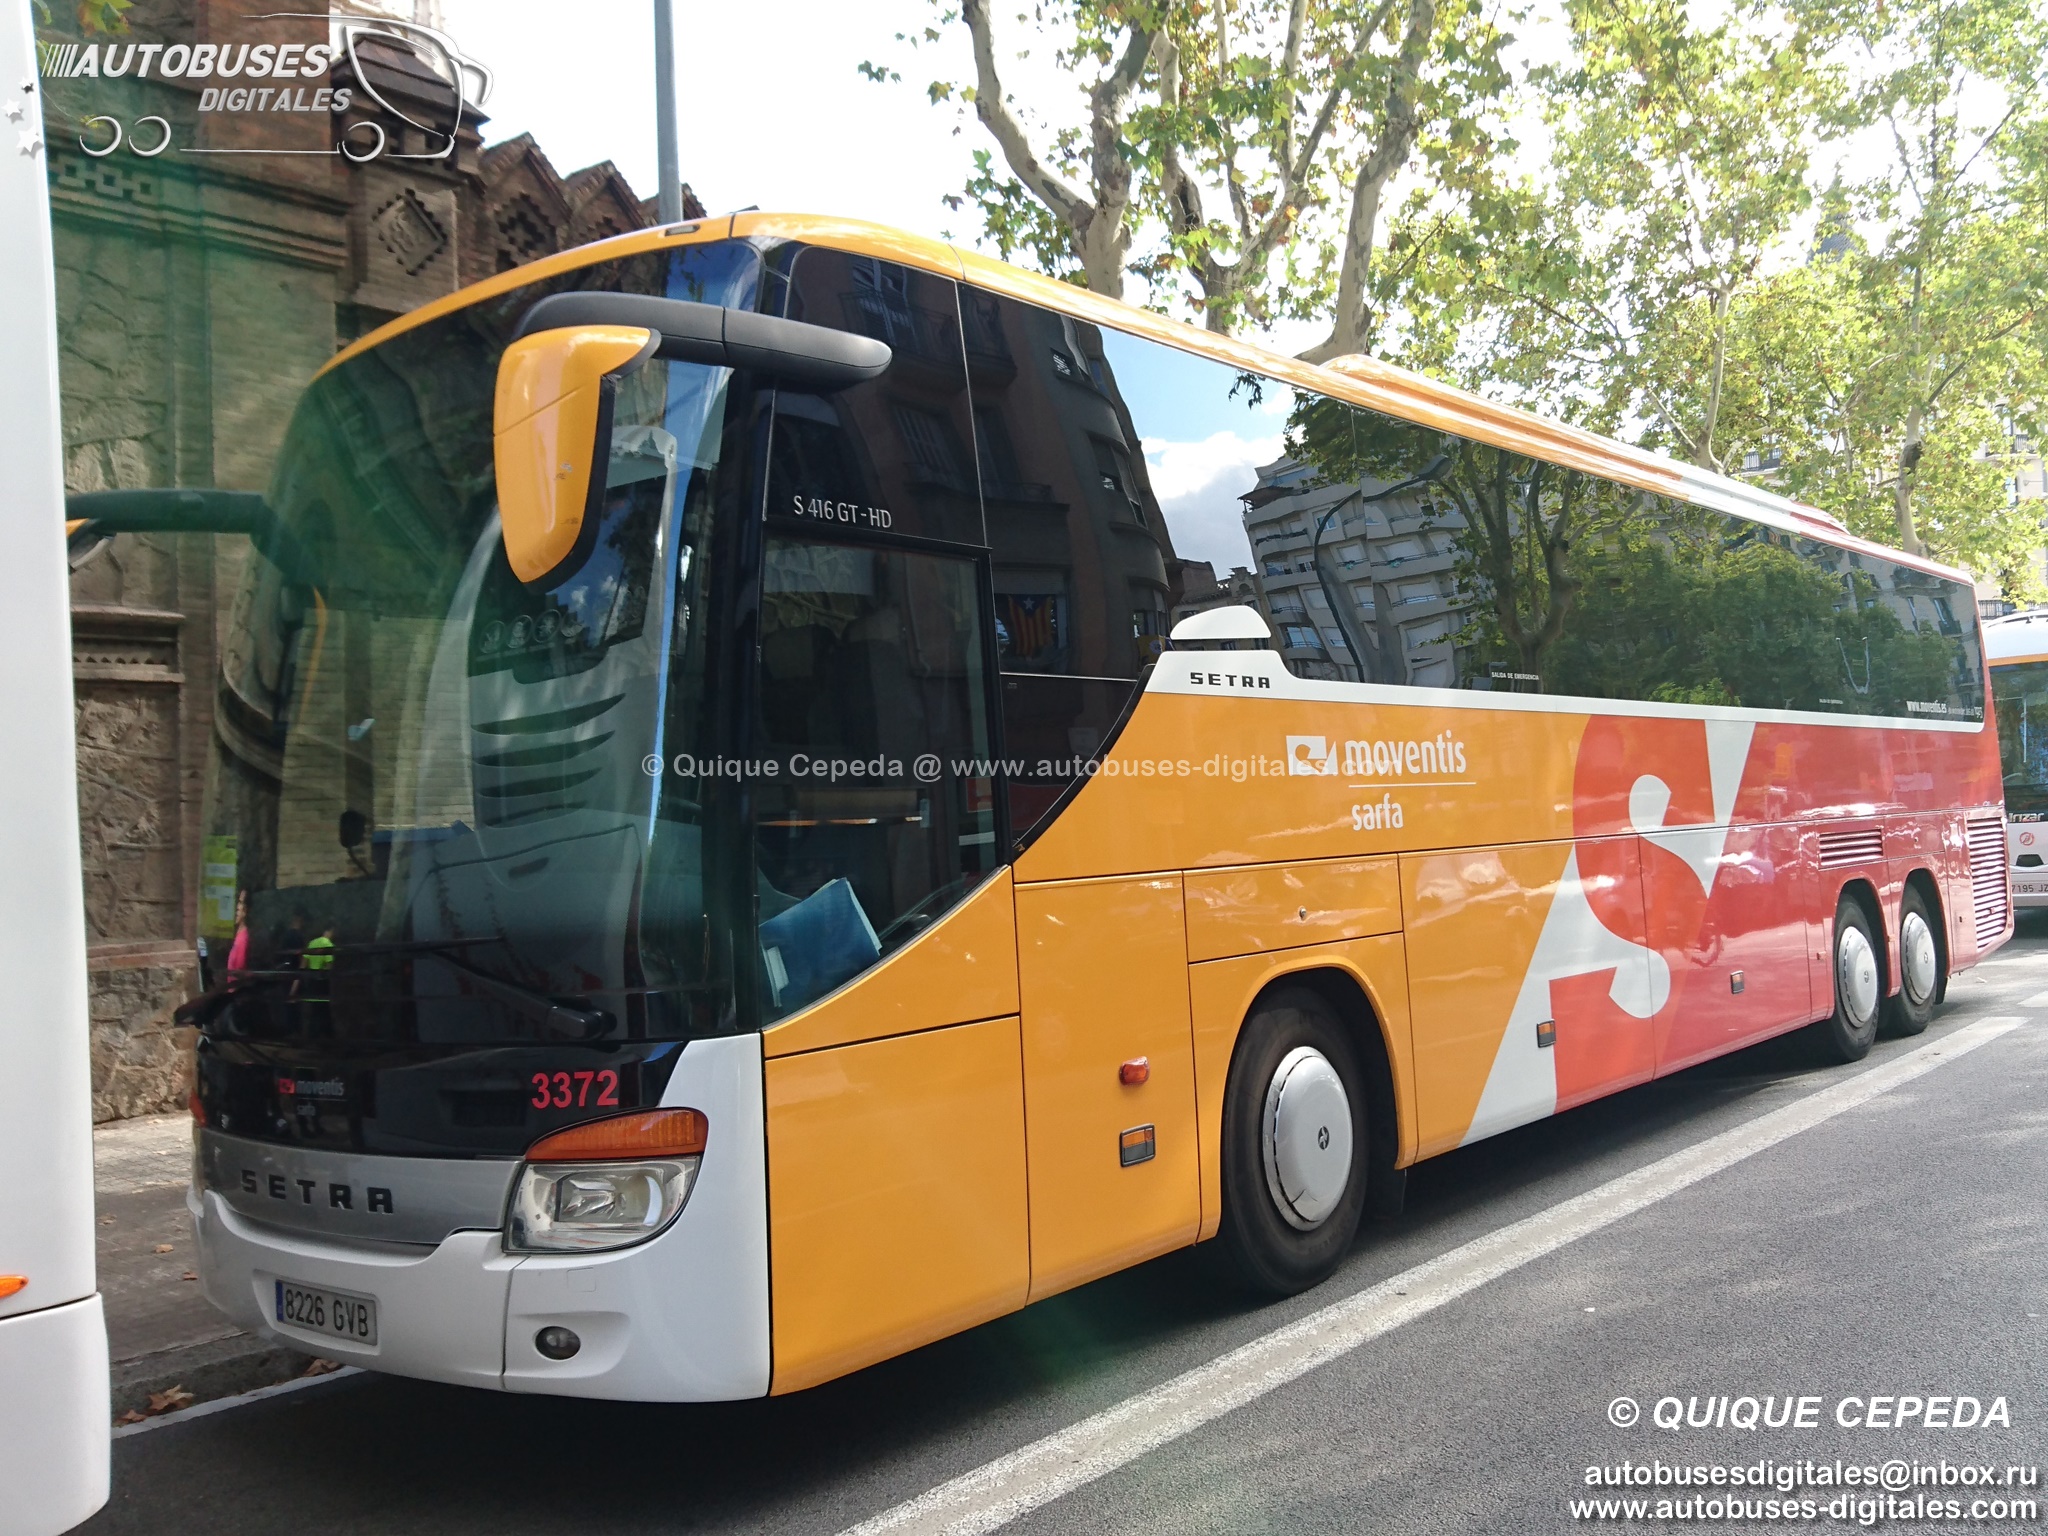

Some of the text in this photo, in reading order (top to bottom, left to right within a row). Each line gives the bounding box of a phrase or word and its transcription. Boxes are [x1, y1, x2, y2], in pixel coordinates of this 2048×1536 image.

[793, 495, 804, 515] S
[807, 498, 834, 520] 416
[1190, 671, 1271, 689] SETRA
[1344, 729, 1467, 775] moventis
[1351, 792, 1404, 831] sarfa
[2012, 884, 2034, 893] 7195
[296, 1077, 346, 1096] moventis
[531, 1069, 619, 1109] 3372
[241, 1169, 394, 1214] SETRA
[285, 1289, 369, 1337] 8226 GVB
